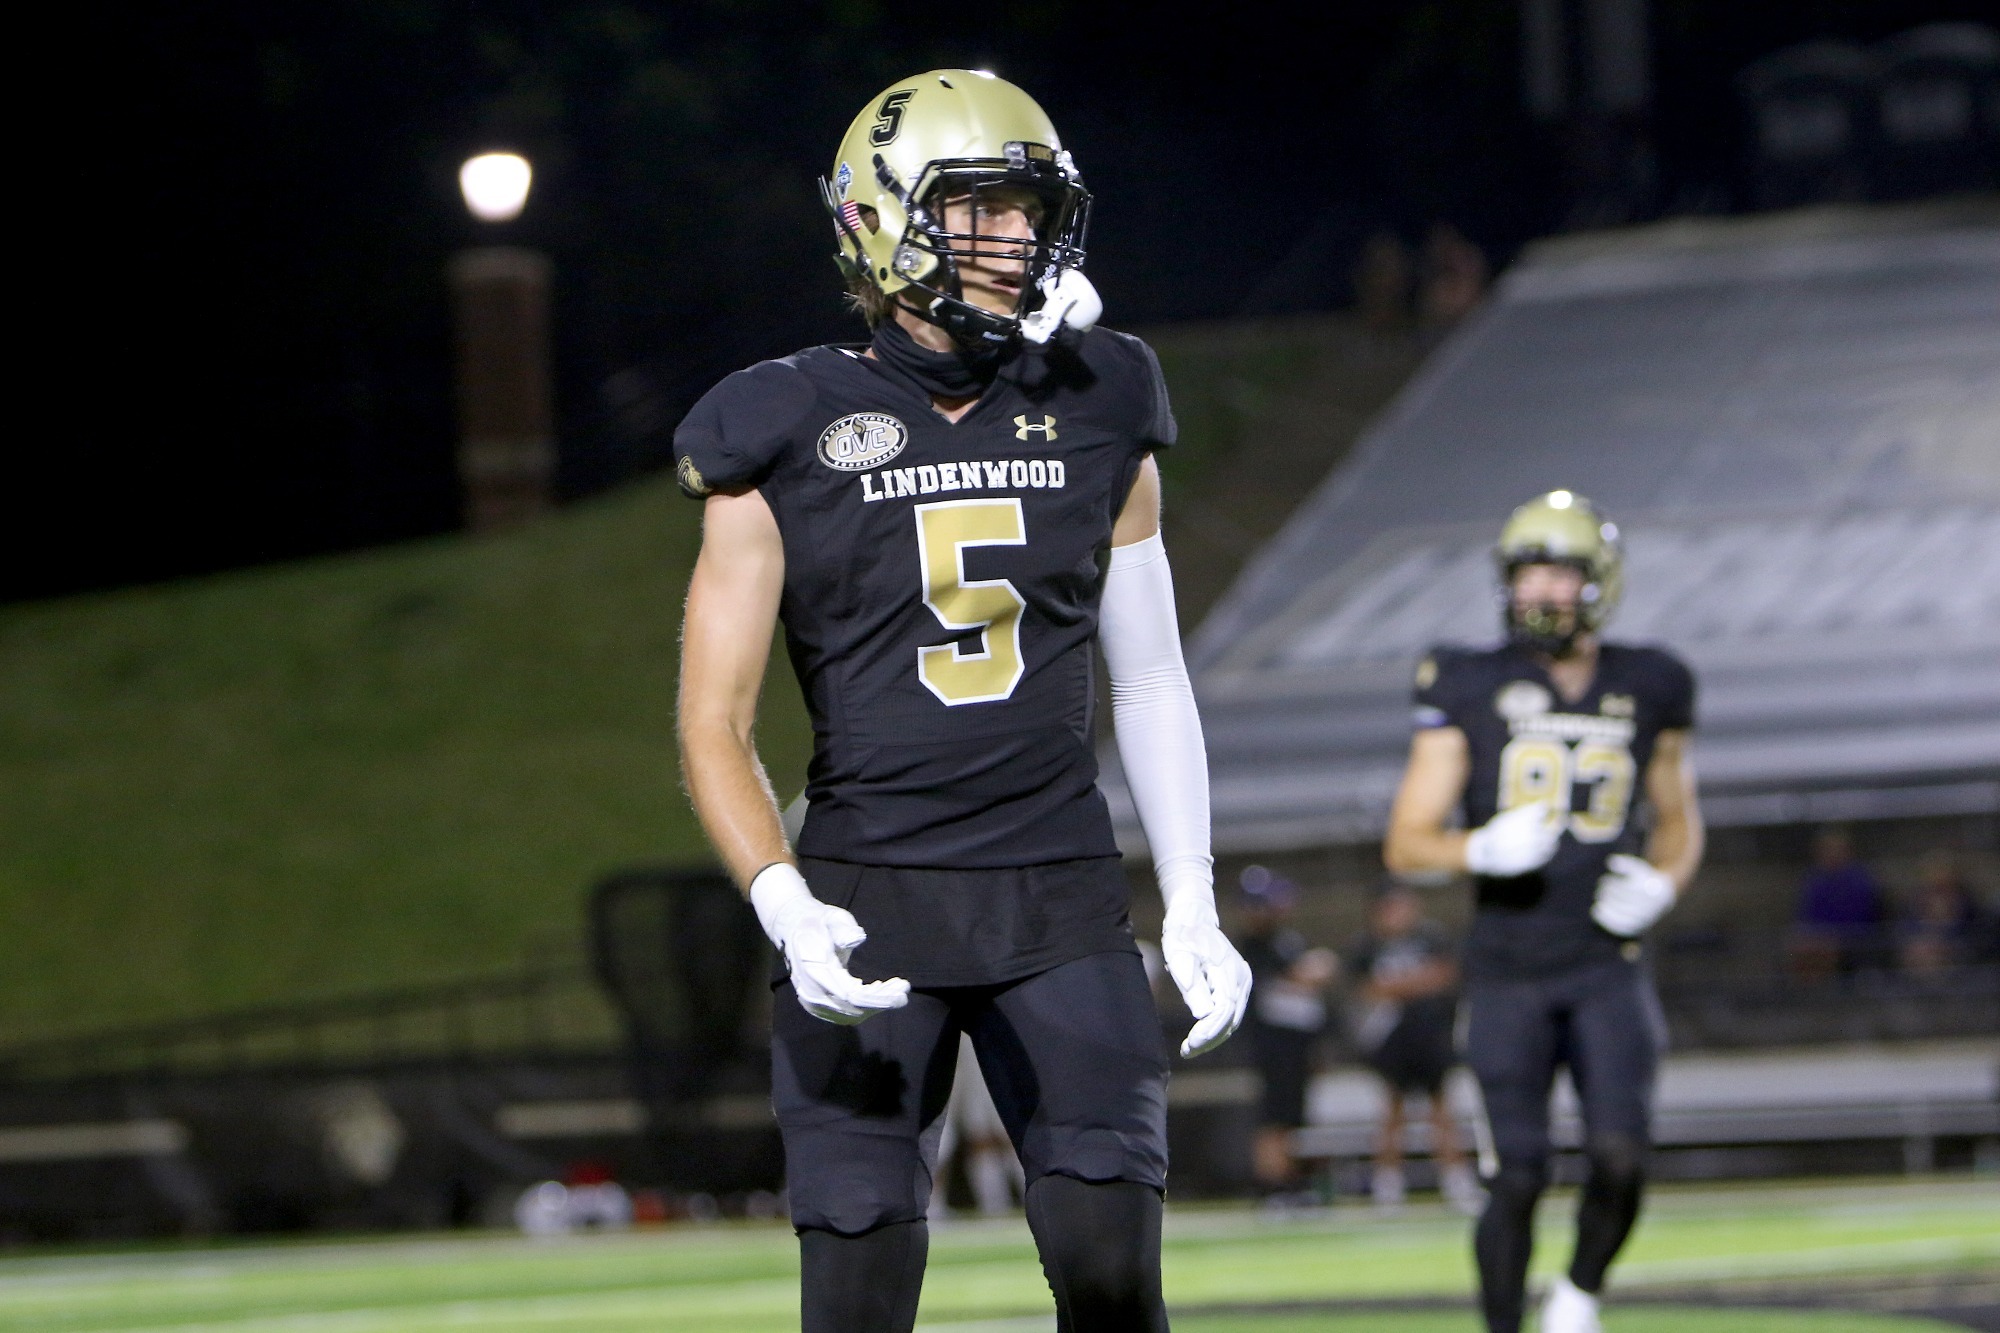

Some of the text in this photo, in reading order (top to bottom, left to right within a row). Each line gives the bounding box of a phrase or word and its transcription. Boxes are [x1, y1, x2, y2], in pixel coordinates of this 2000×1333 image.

[869, 89, 917, 147] 5
[837, 427, 887, 458] OVC
[860, 460, 1066, 502] LINDENWOOD
[914, 498, 1027, 706] 5
[1496, 739, 1637, 843] 93
